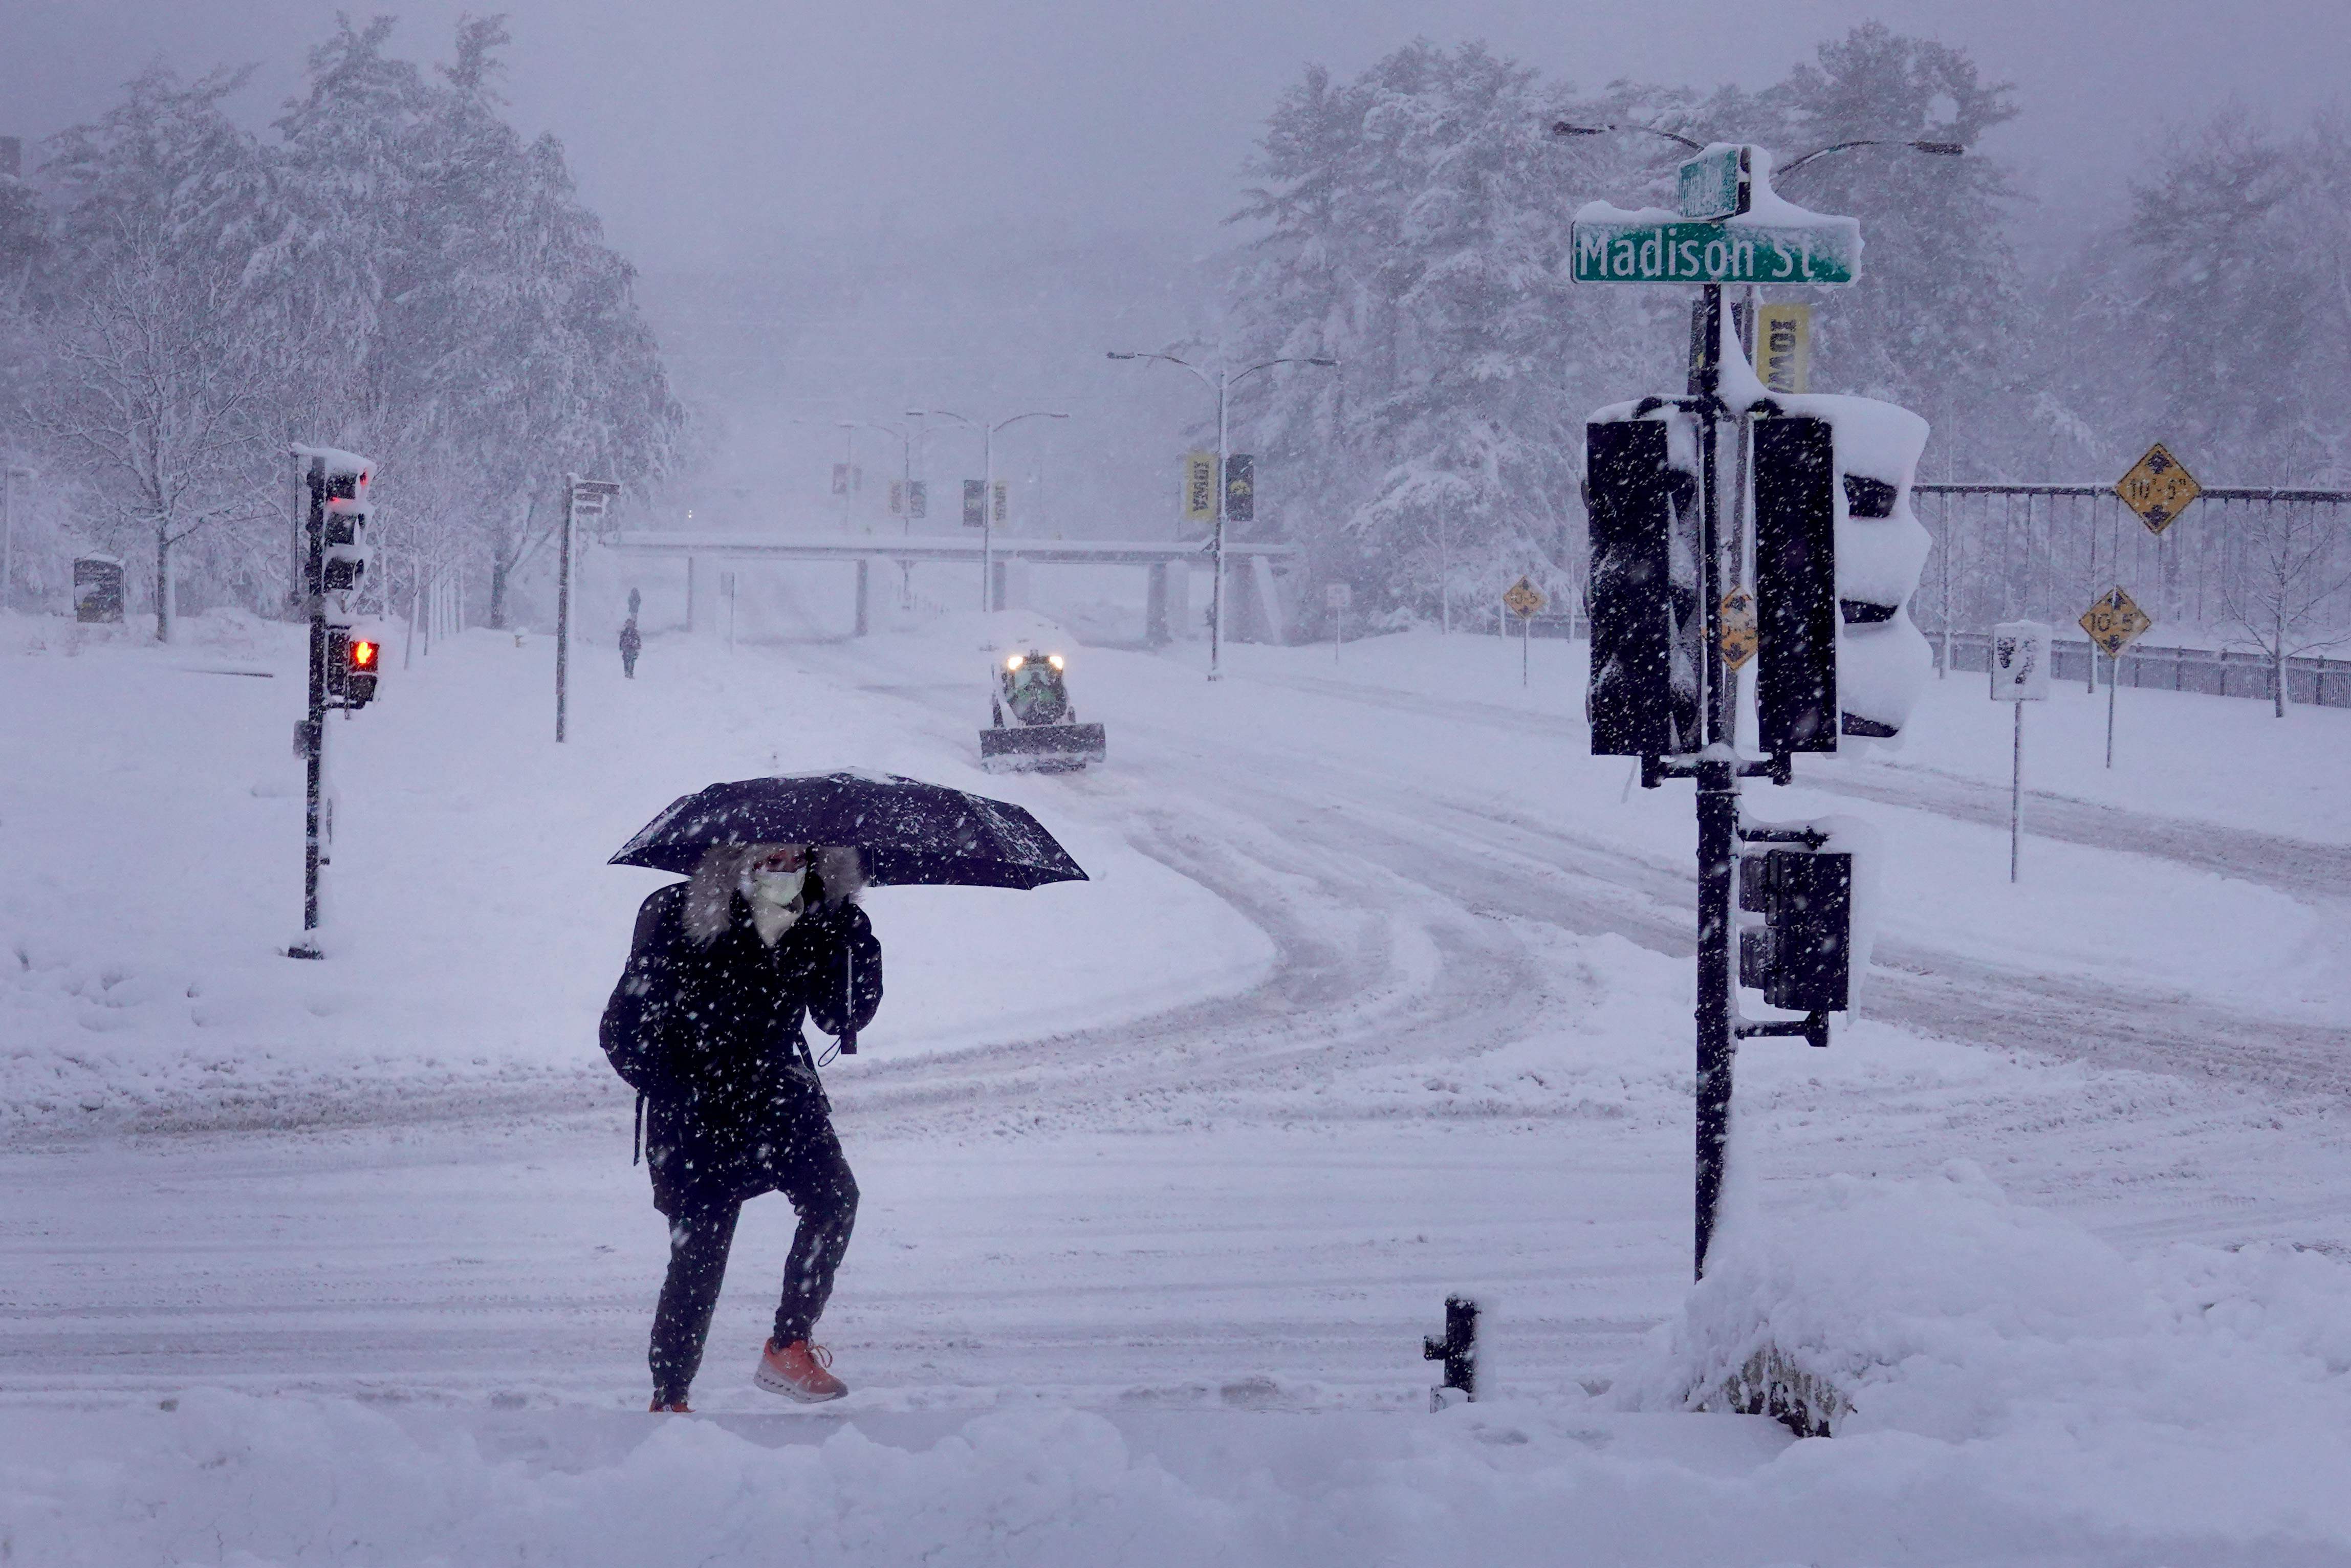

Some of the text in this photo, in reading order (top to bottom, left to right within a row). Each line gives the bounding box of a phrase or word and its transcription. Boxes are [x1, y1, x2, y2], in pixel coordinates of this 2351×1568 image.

[1580, 228, 1815, 277] Madison St
[1193, 461, 1209, 511] IOWA
